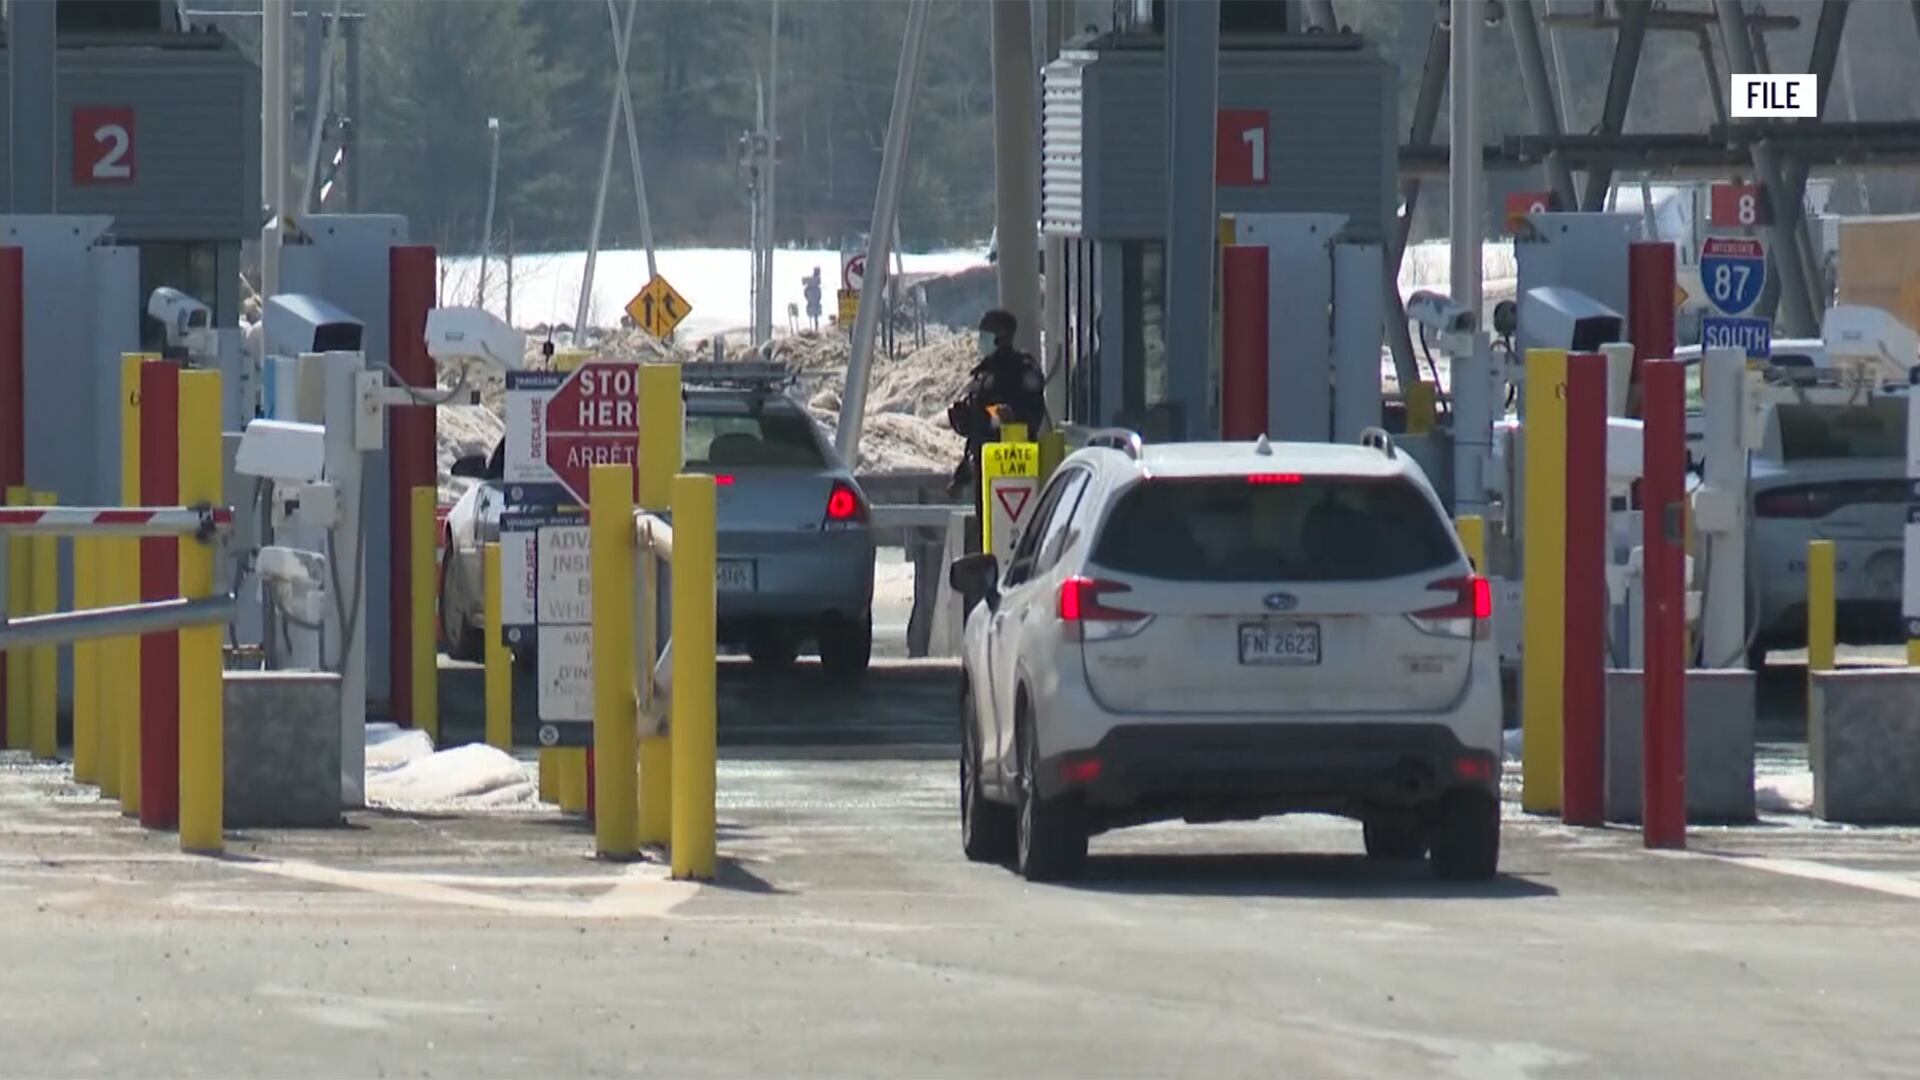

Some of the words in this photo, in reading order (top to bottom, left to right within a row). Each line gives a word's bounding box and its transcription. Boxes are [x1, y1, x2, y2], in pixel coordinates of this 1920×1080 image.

[93, 125, 130, 177] 2
[1242, 127, 1265, 180] 1
[1739, 195, 1756, 224] 8
[1714, 264, 1751, 302] 87
[1706, 325, 1767, 351] SOUTH
[579, 370, 639, 396] STO
[579, 401, 639, 426] HER
[566, 441, 639, 468] ARRÊT
[994, 448, 1031, 460] STATE
[1000, 463, 1026, 474] LAW
[550, 531, 591, 549] ADV
[552, 555, 590, 572] INS
[559, 665, 592, 680] D'IN
